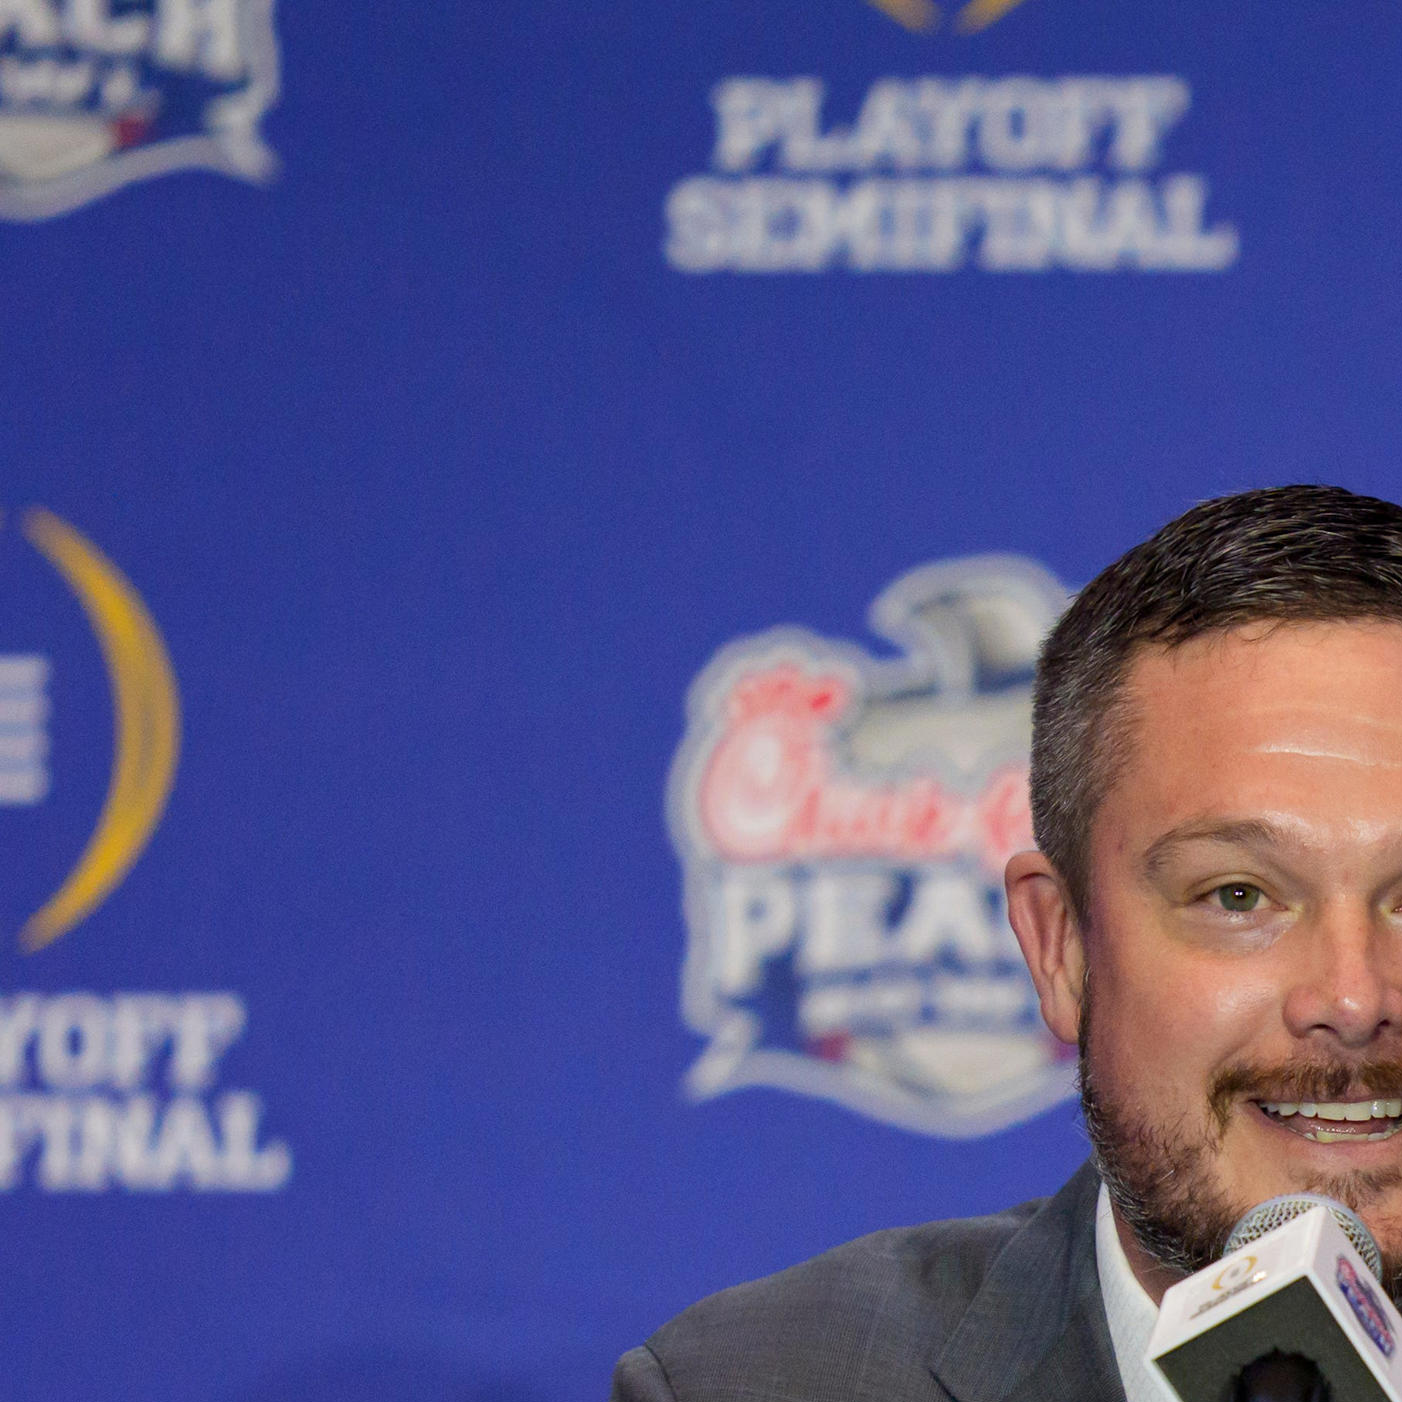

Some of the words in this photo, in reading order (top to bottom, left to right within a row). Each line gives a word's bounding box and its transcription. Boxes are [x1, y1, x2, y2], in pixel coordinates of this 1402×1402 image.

[709, 74, 1193, 173] PLAYOFF
[662, 172, 1242, 274] SEMIFINAL
[716, 866, 1030, 1000] PEA
